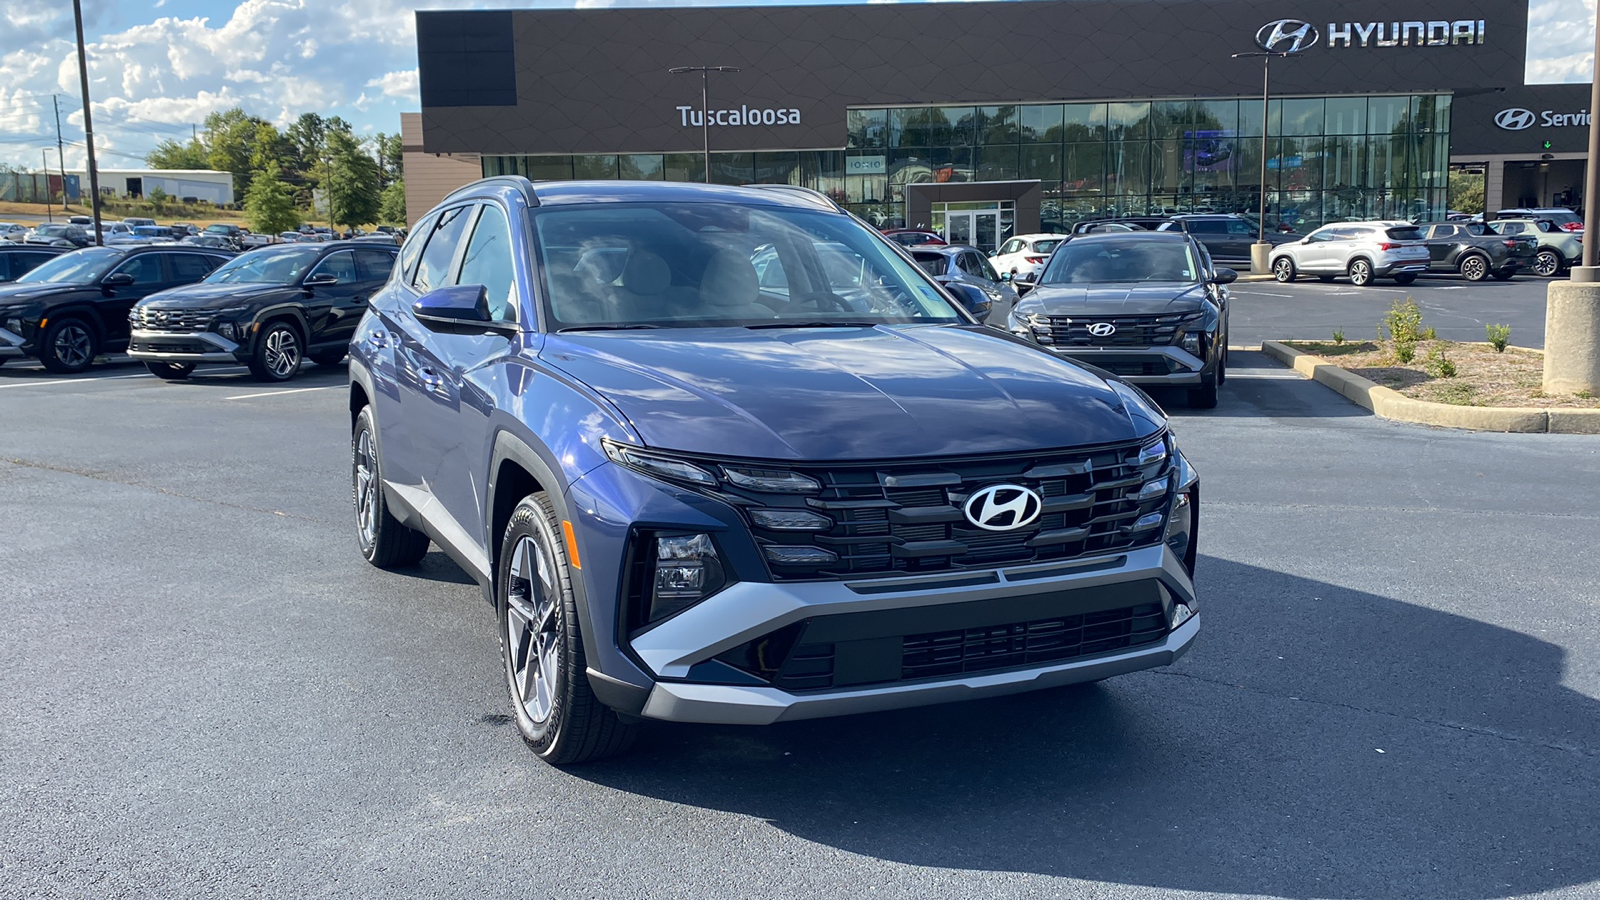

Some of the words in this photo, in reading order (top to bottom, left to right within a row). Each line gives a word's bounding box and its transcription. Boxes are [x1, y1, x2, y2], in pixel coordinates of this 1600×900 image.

[1327, 19, 1484, 48] HYUNDAI
[675, 104, 801, 127] Tuscaloosa
[1540, 109, 1591, 127] Servic
